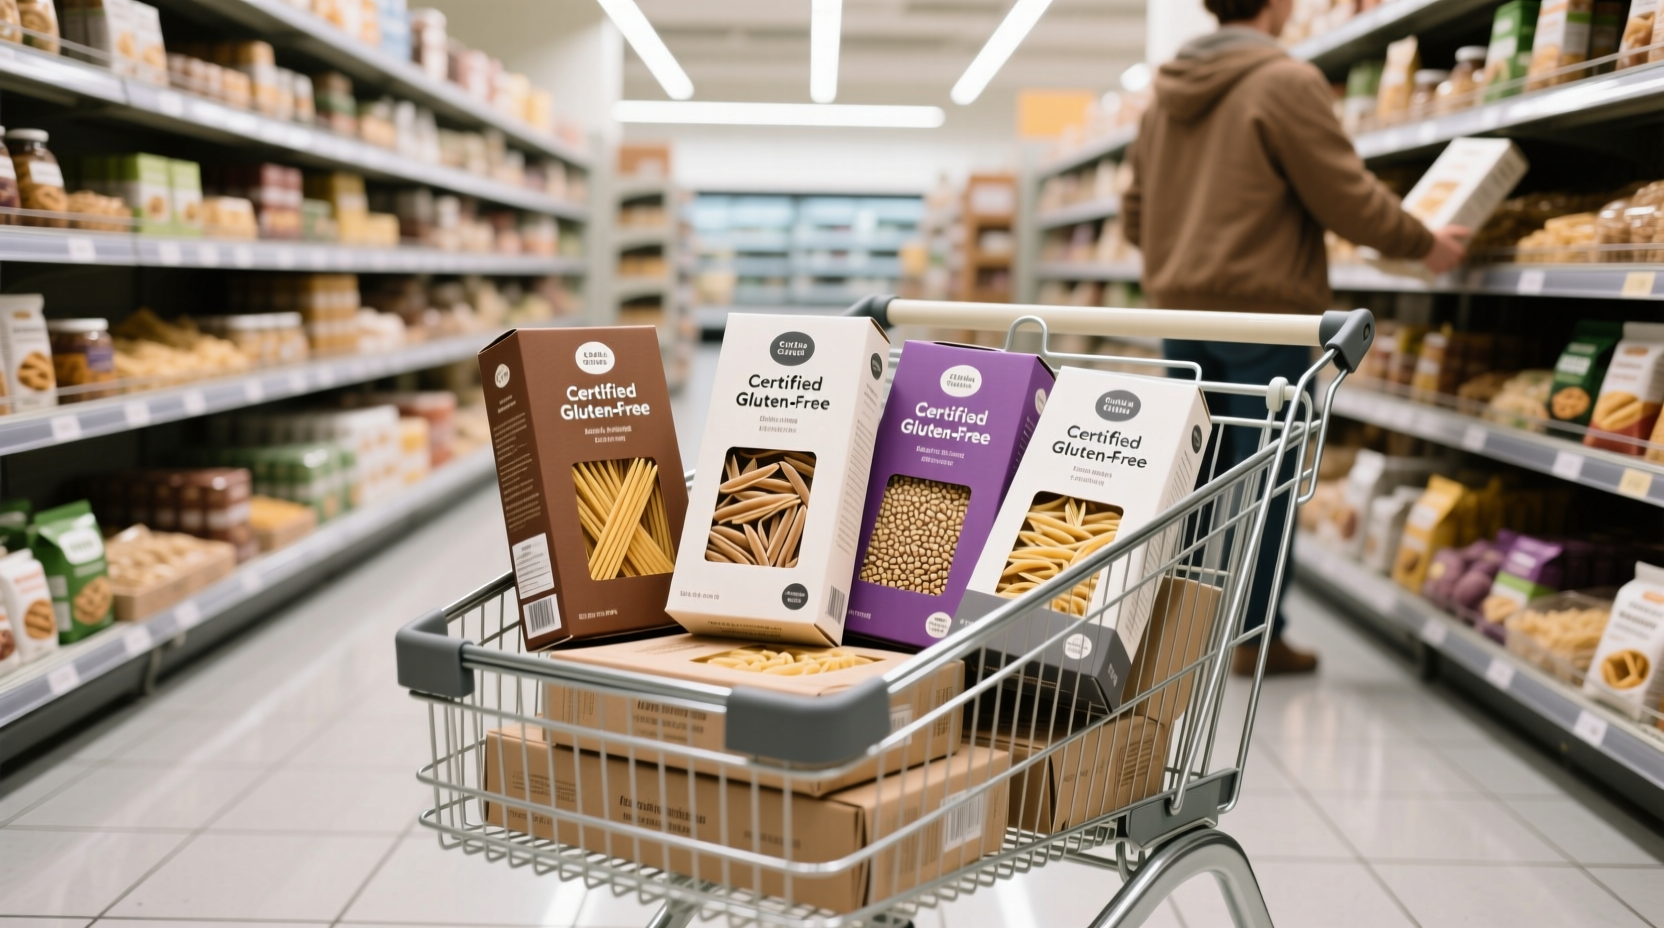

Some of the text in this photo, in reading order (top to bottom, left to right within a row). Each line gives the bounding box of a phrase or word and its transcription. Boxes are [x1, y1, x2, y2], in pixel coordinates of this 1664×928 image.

[748, 374, 823, 391] Certified
[560, 402, 650, 420] Gluten-Free
[736, 391, 830, 410] Gluten-Free
[901, 418, 991, 445] Gluten-Free
[1067, 425, 1142, 449] Certified
[1052, 440, 1148, 468] Gluten-Free
